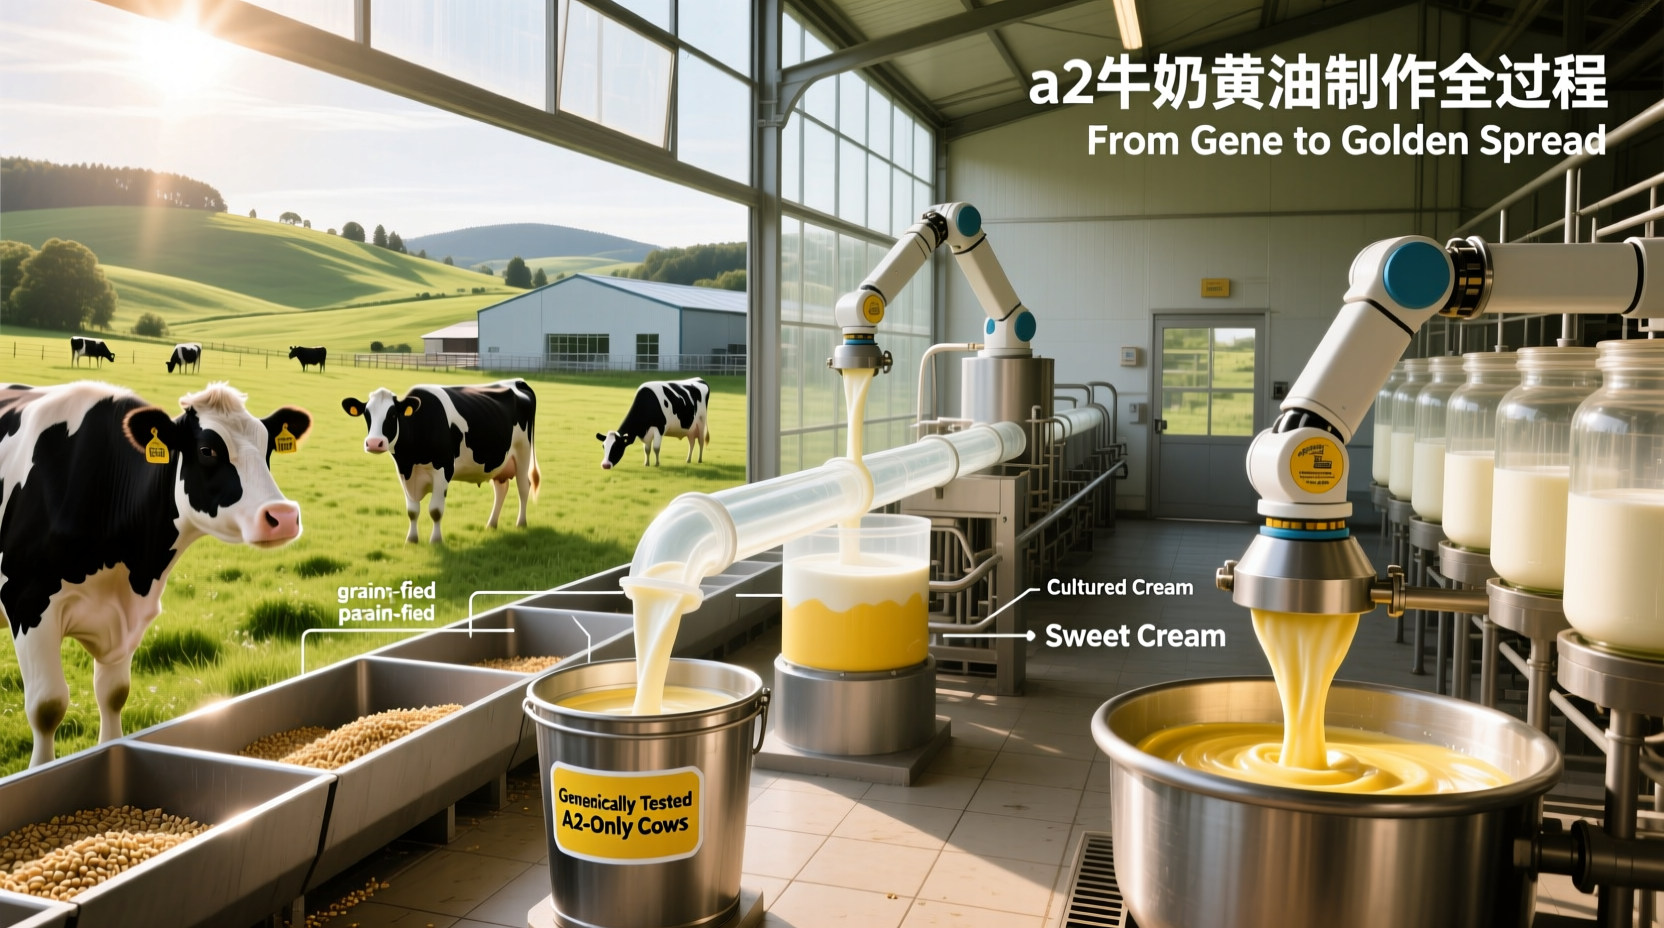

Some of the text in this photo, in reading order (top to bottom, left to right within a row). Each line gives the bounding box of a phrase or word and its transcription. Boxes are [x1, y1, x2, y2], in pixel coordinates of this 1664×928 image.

[639, 790, 693, 811] Tested
[562, 809, 689, 840] A2-Only Cows
